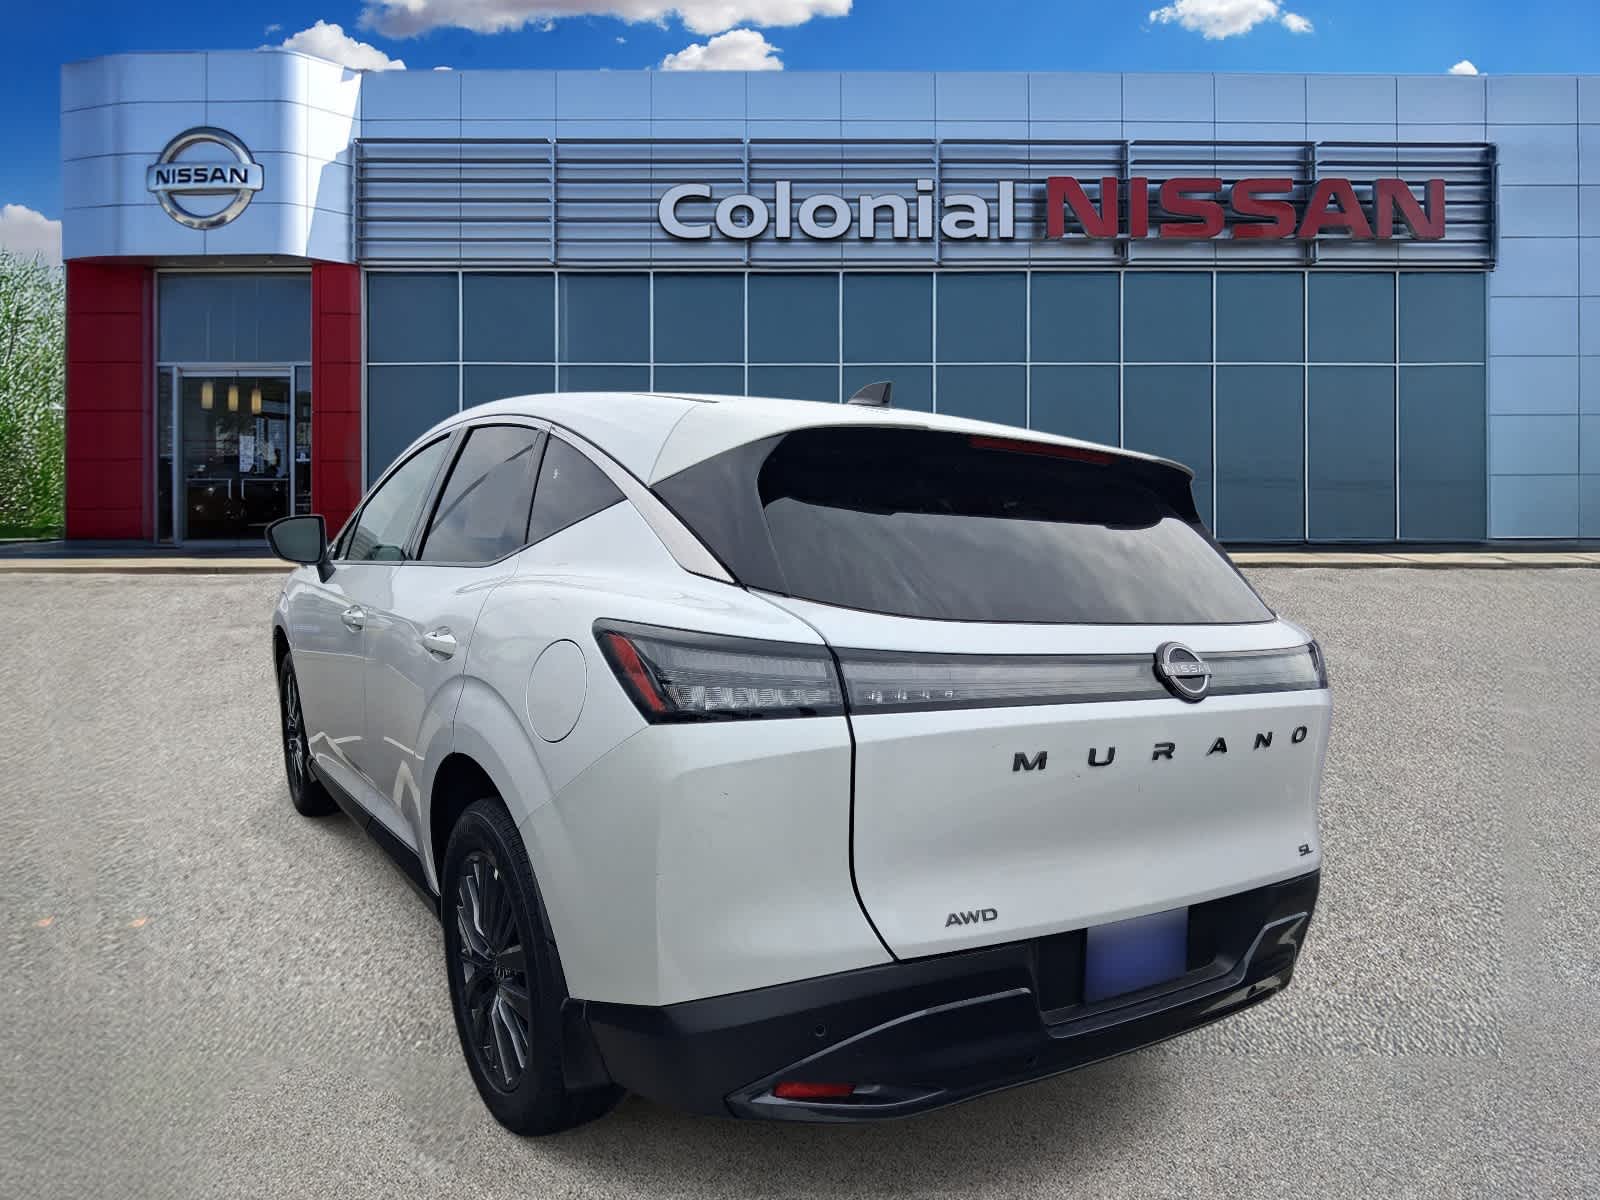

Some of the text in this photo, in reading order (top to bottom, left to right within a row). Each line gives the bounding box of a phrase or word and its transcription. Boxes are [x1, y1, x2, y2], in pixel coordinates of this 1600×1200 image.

[155, 167, 248, 185] NISSAN
[658, 176, 1446, 240] Colonial NISSAN
[1012, 725, 1308, 772] MURANO
[1298, 843, 1314, 856] SL
[945, 908, 998, 928] AWD
